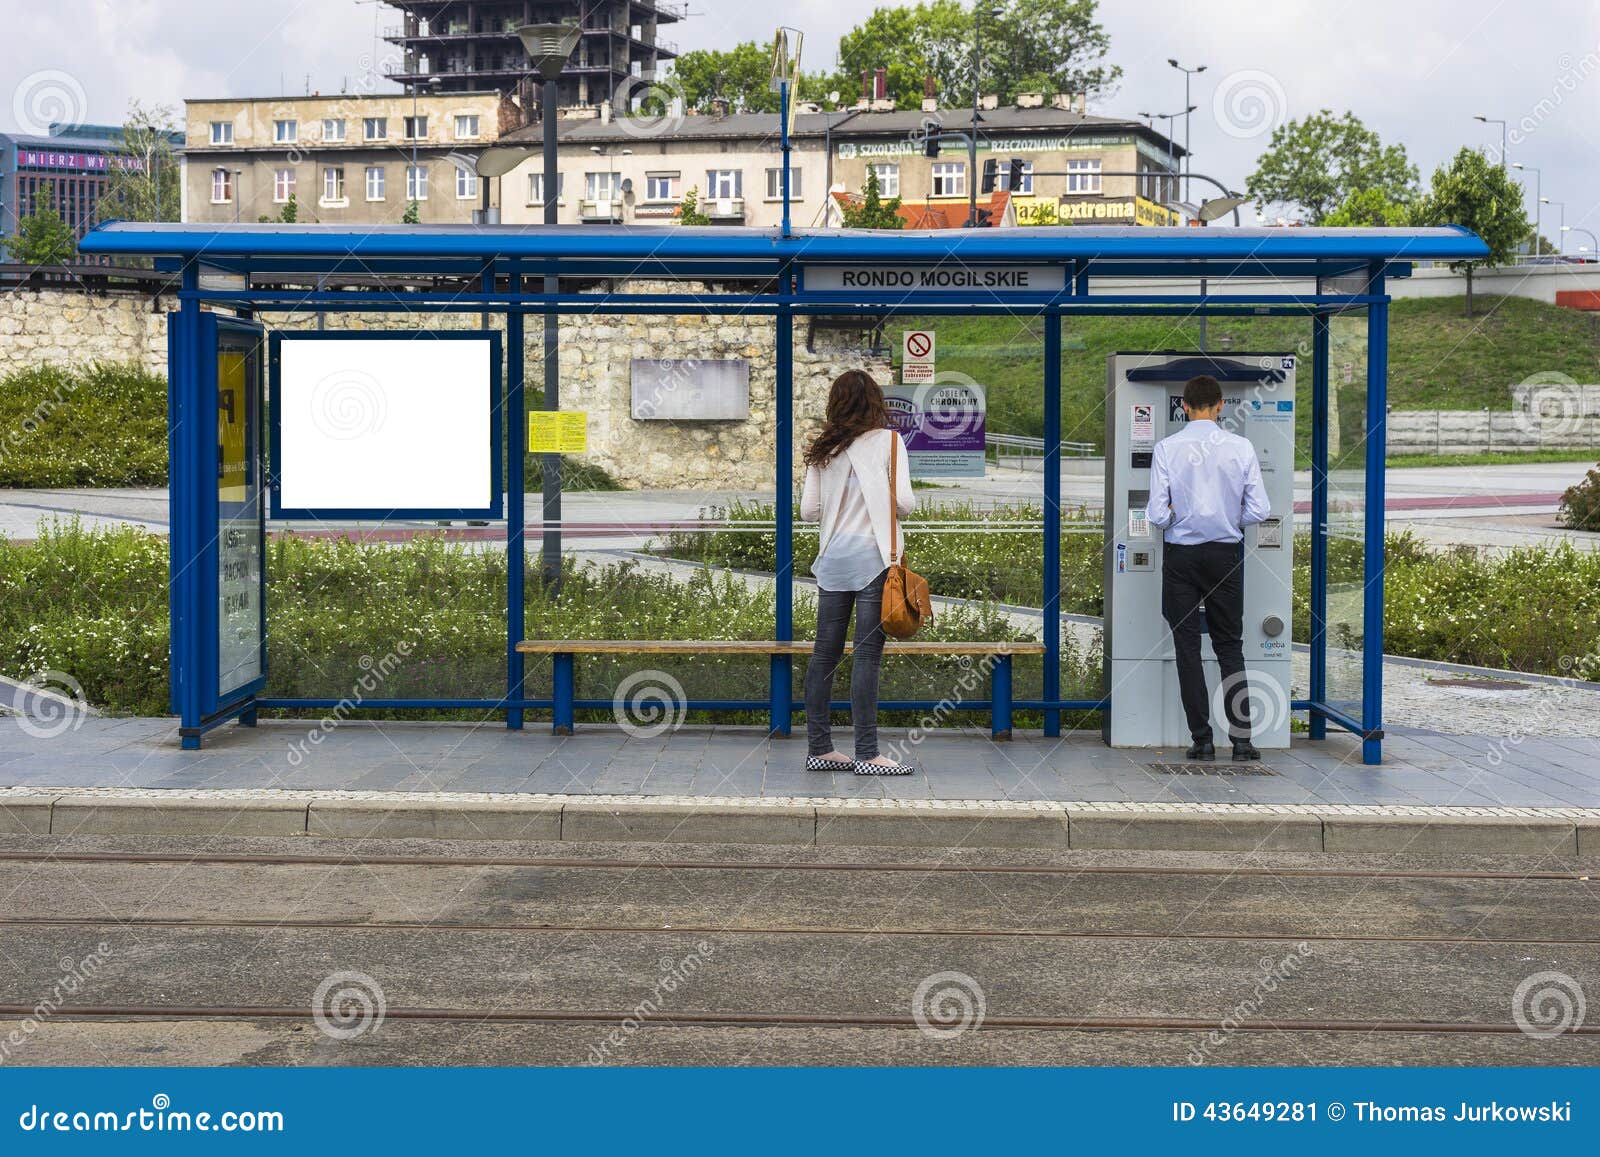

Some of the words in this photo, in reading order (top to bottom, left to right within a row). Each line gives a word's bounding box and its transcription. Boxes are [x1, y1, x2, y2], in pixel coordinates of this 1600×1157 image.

[28, 153, 75, 167] MIERZ
[1059, 201, 1136, 219] extrema
[842, 270, 914, 287] RONDO
[920, 270, 1029, 287] MOGILSKIE
